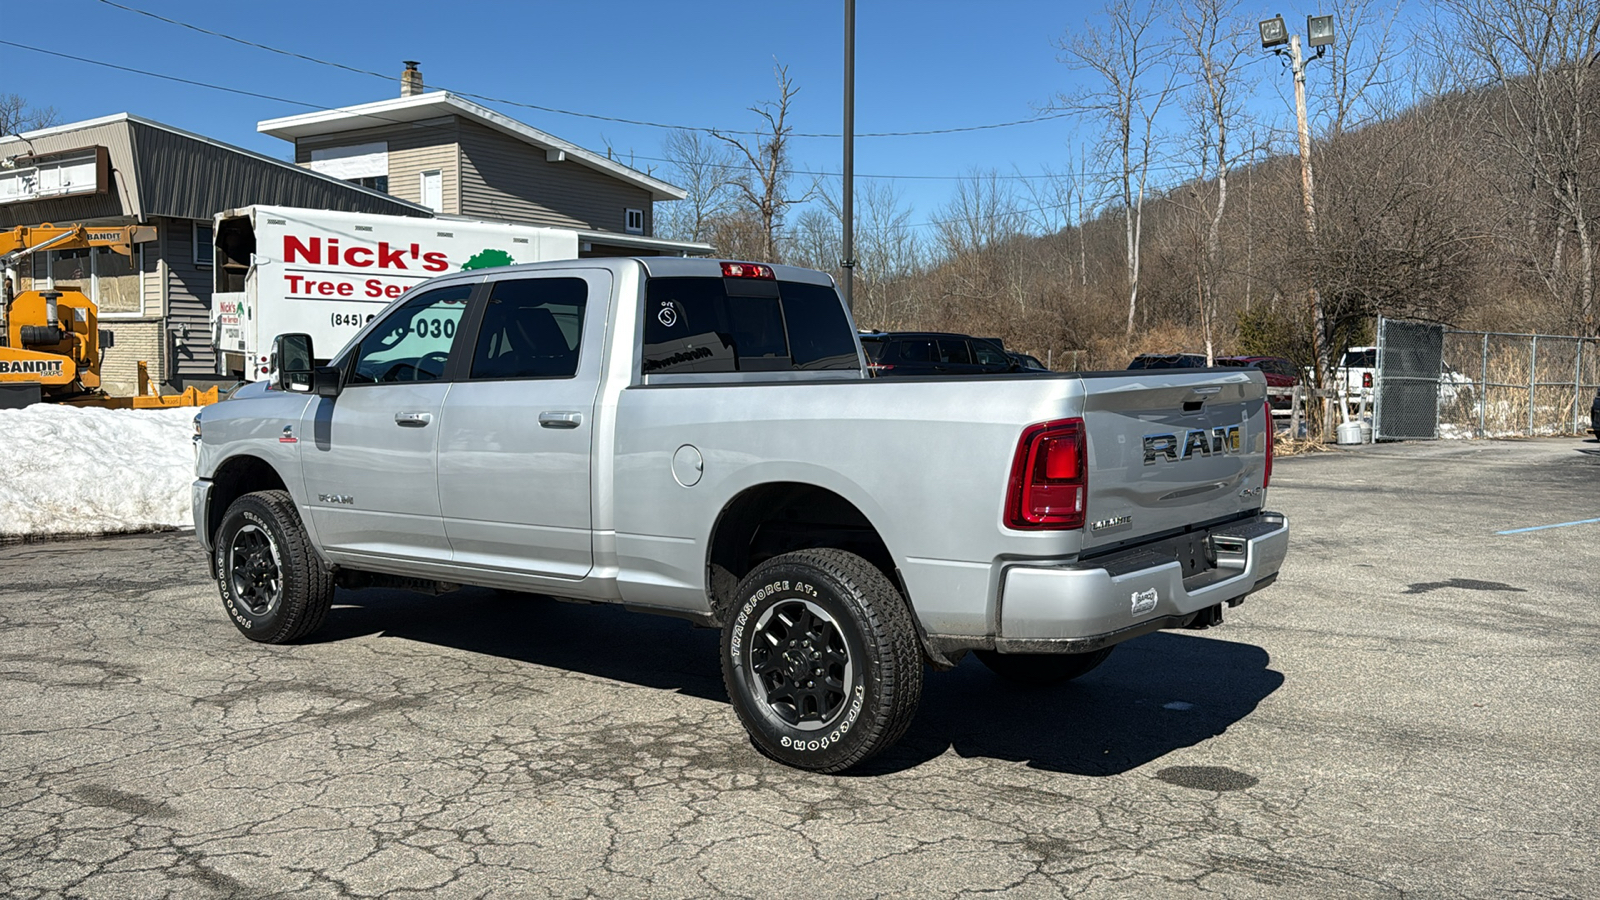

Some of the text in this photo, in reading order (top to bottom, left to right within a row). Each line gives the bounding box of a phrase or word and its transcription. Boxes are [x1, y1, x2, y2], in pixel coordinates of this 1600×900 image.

[86, 232, 121, 240] BANDIT
[284, 235, 449, 272] Nick's
[284, 275, 354, 296] Tree
[220, 301, 236, 313] Nick's
[331, 312, 362, 328] (845)
[0, 361, 63, 373] BANDIT
[1142, 424, 1240, 466] RAM
[731, 581, 790, 657] TRANSFORCE
[780, 685, 865, 751] Firestone
